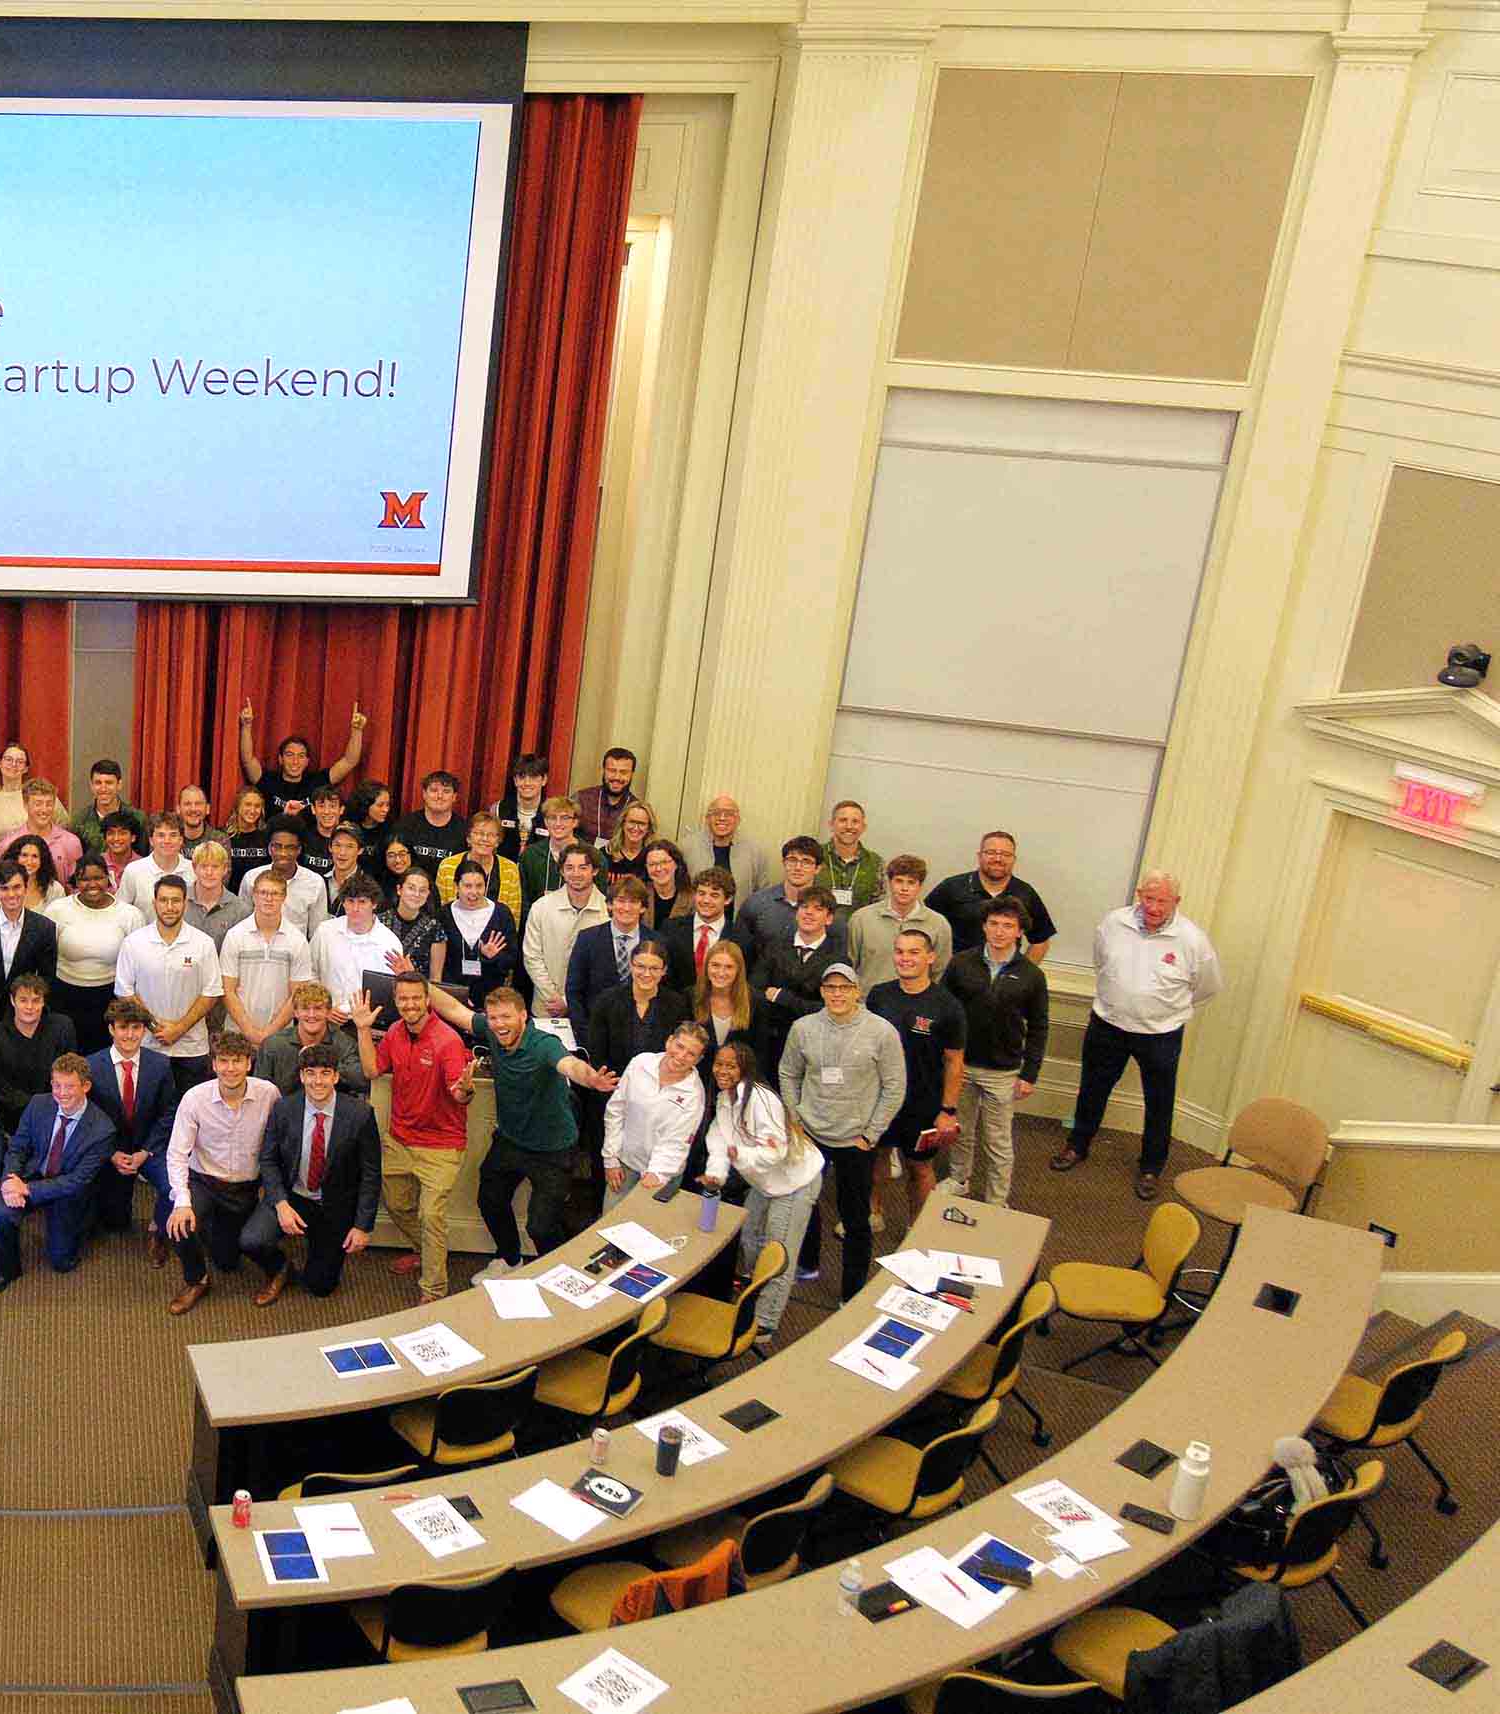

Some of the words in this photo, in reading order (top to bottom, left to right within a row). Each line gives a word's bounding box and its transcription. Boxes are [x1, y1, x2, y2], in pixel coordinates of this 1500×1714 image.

[151, 357, 398, 400] Weekend!
[377, 491, 429, 529] M
[1399, 782, 1463, 825] EXIT
[595, 1482, 625, 1500] RUN
